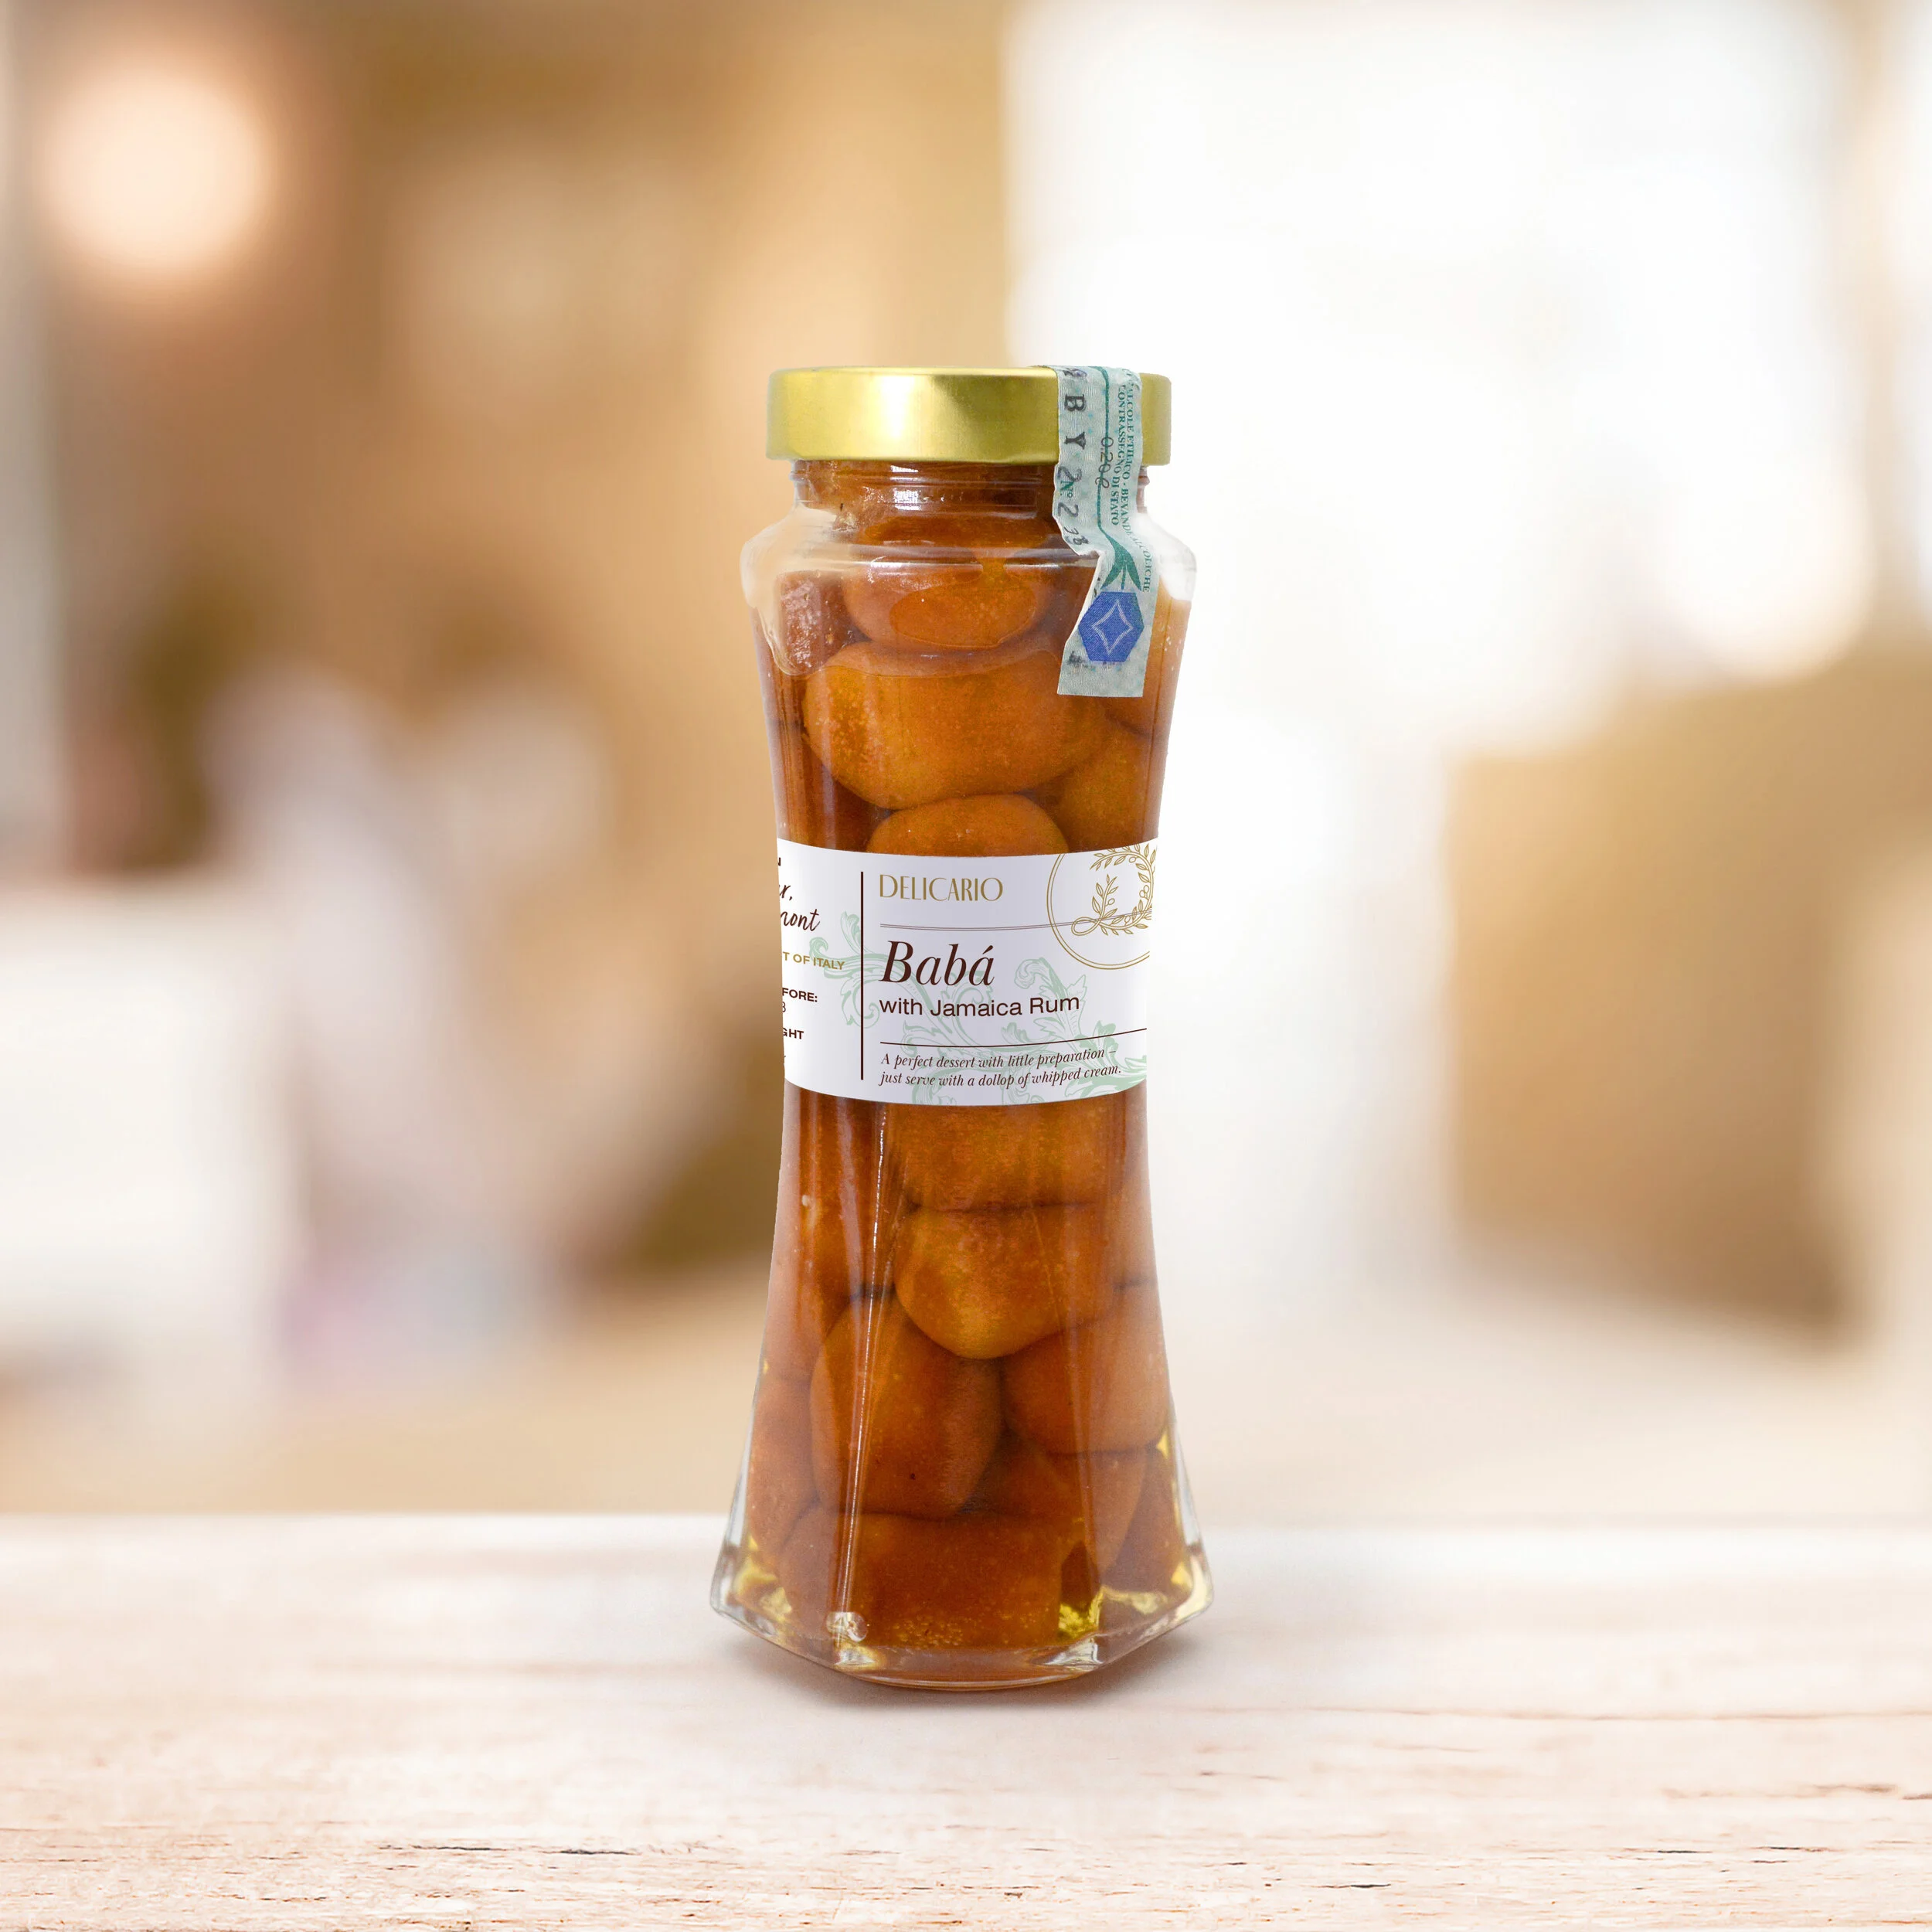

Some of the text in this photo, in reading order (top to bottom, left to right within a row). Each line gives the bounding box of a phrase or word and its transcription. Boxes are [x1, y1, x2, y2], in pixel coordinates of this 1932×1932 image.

[1122, 434, 1134, 480] ETILICO
[1111, 476, 1121, 488] DI
[1110, 490, 1120, 526] STATO
[879, 874, 1003, 901] DELICARIO
[793, 954, 811, 964] OF
[813, 957, 845, 970] ITALY
[879, 940, 995, 986] Babá
[879, 996, 1080, 1017] with Jamaica Rum
[881, 1053, 890, 1065] A
[893, 1054, 934, 1071] perfect
[936, 1056, 975, 1068] dessert
[978, 1055, 1004, 1068] with
[1008, 1054, 1034, 1067] little
[1036, 1048, 1105, 1070] preparation
[878, 1065, 1121, 1090] just serve with a dollop of whipped cream.
